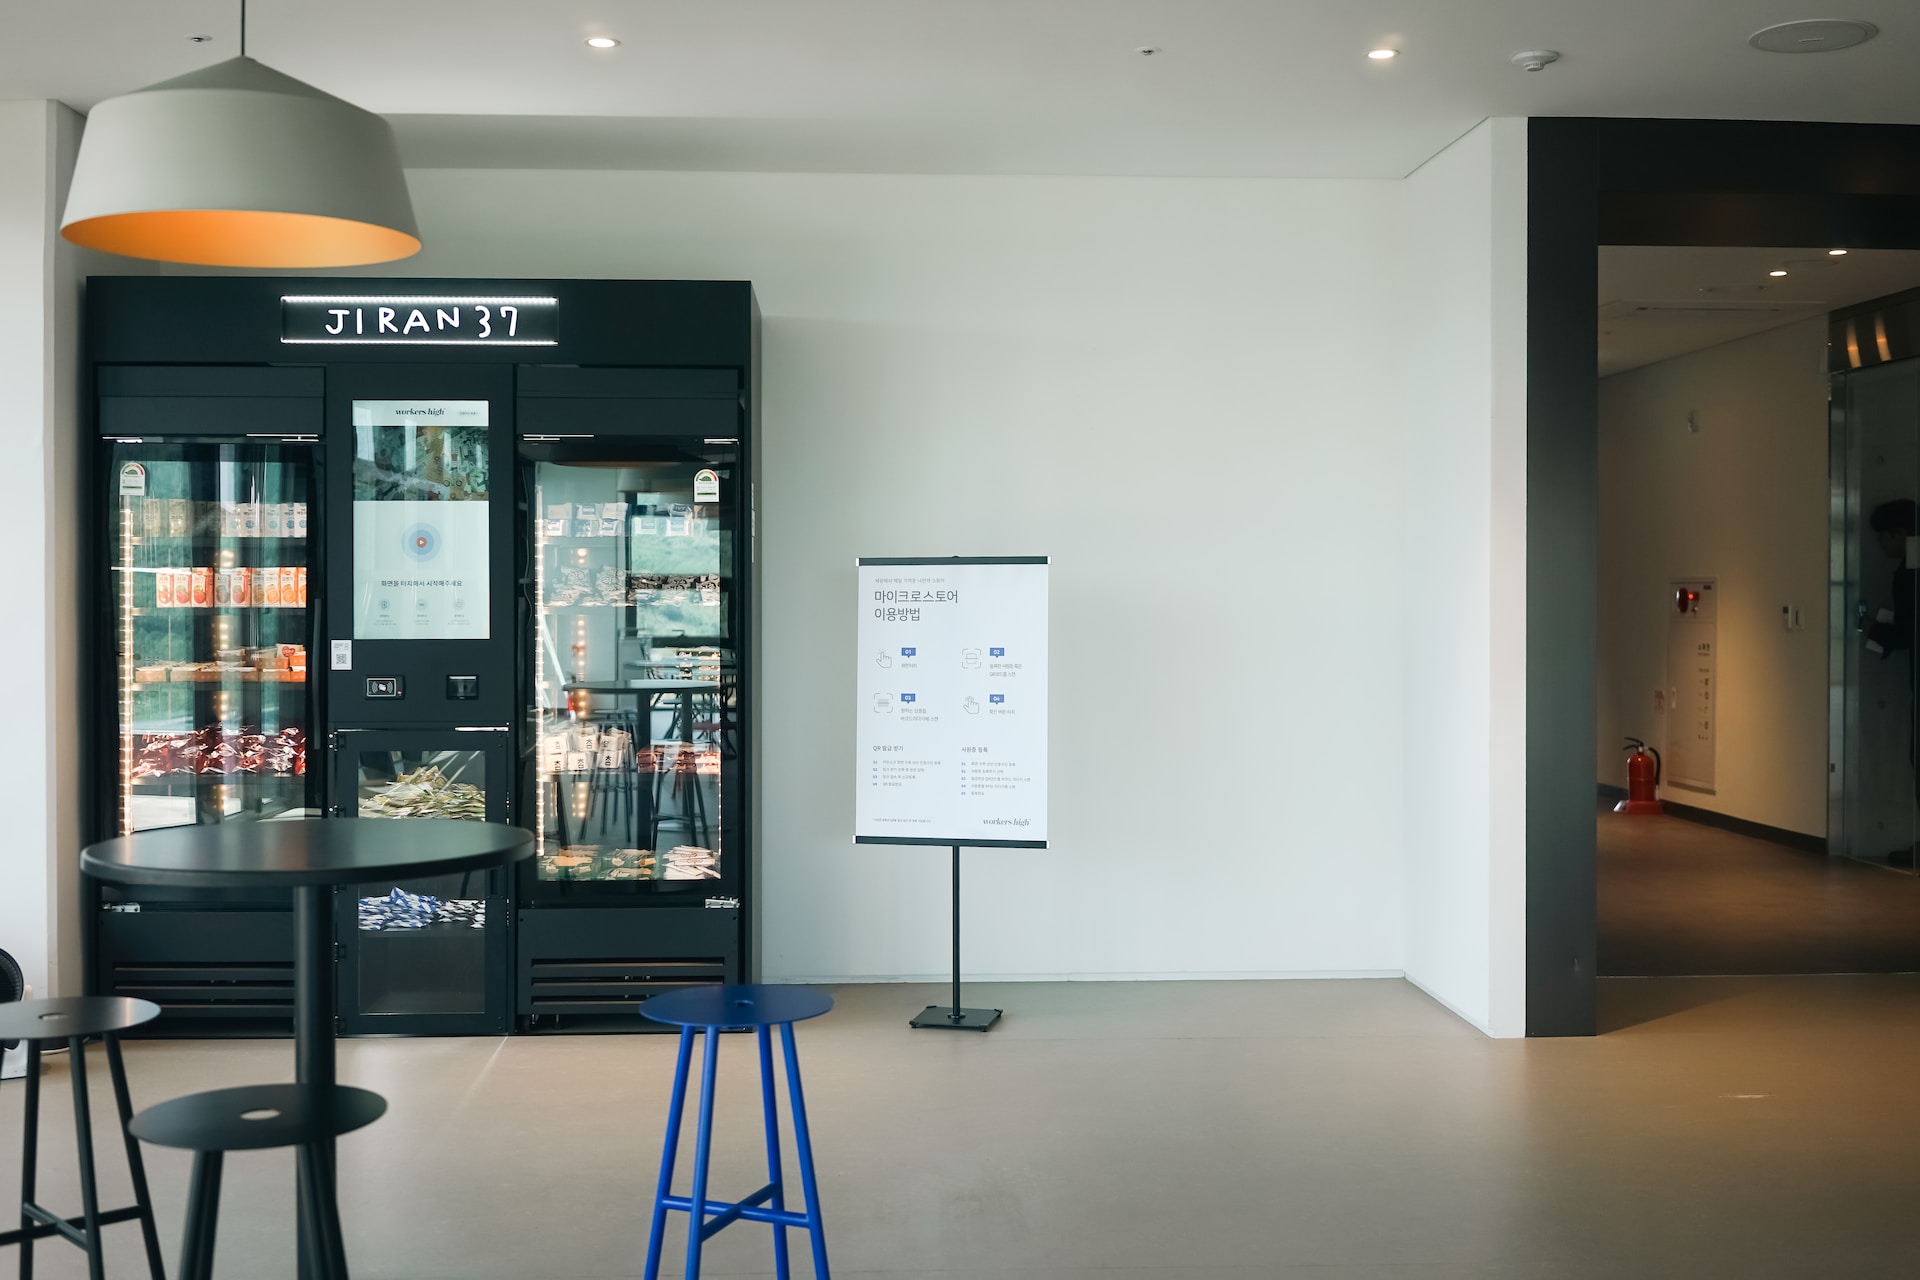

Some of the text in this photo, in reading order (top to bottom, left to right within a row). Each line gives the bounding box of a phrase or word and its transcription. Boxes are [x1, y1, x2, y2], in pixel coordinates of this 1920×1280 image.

[474, 305, 518, 338] 37
[395, 407, 445, 417] workers high
[874, 589, 959, 604] 마이크로스토어
[874, 607, 921, 622] 이용방법
[983, 817, 1030, 827] workers high
